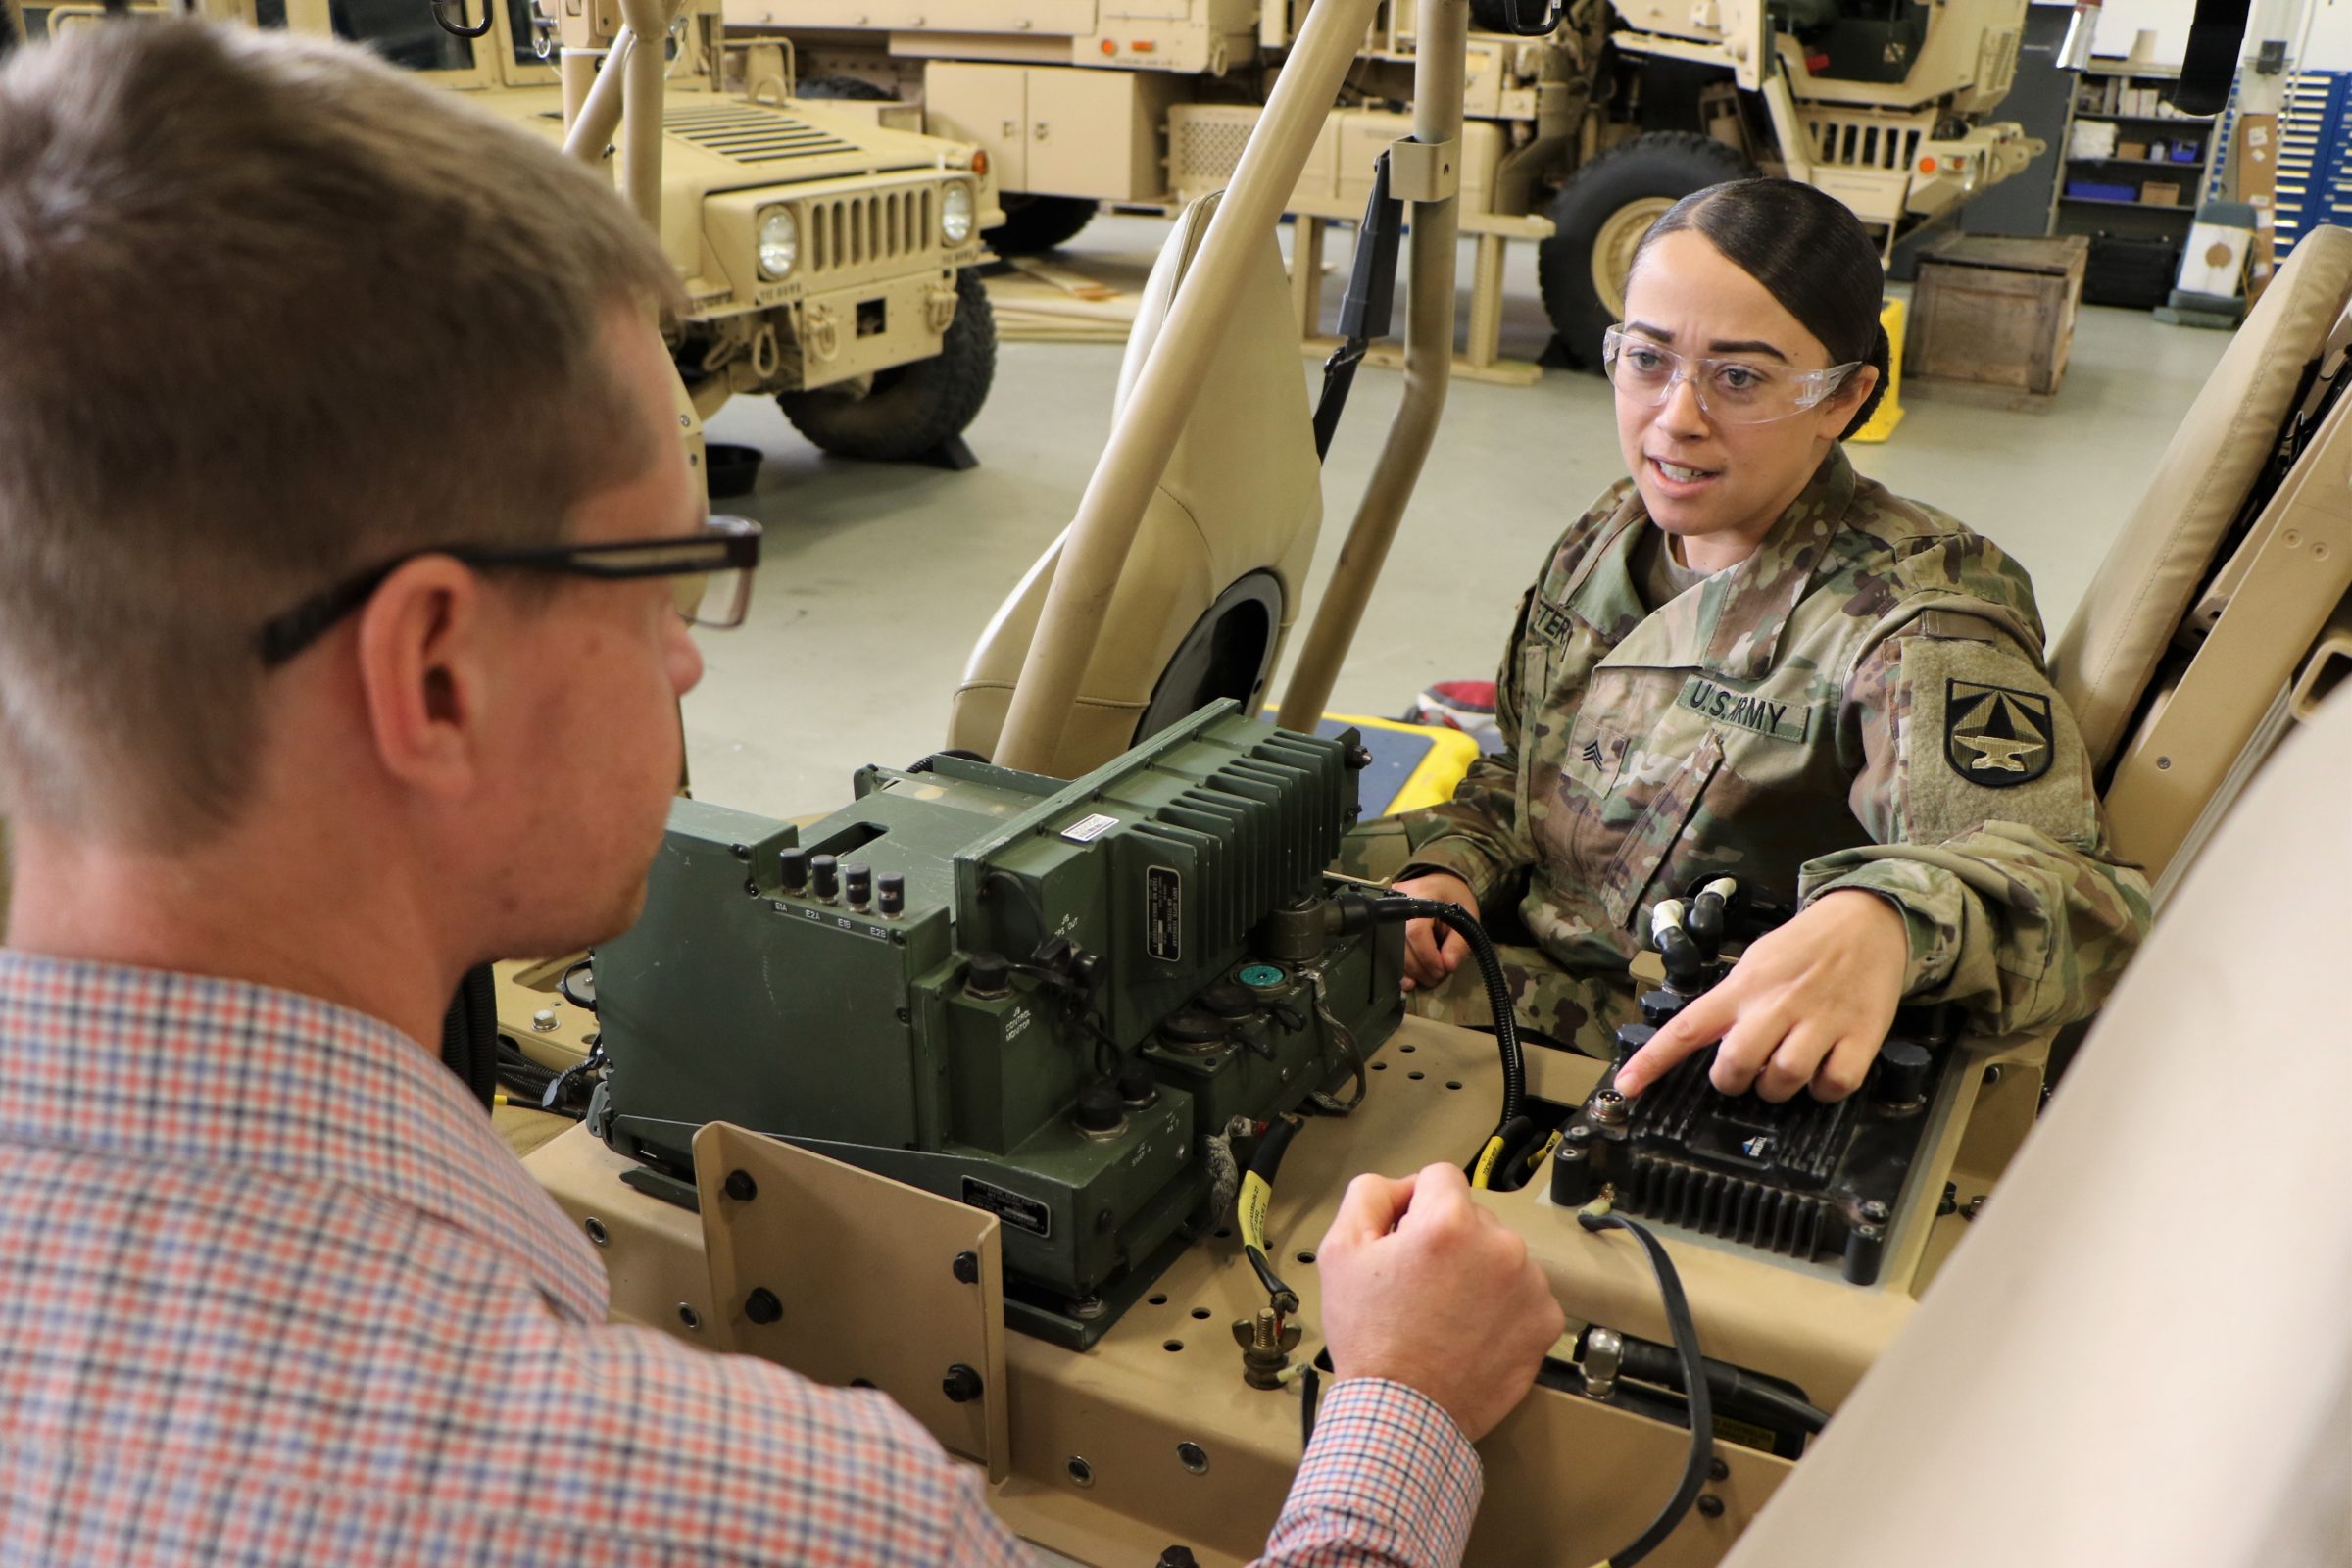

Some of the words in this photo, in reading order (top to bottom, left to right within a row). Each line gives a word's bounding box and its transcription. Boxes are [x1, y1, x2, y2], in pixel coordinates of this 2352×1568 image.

[775, 902, 788, 913] E1A
[805, 909, 821, 921] E2A
[838, 918, 852, 929] E1B
[870, 926, 887, 938] E2B
[1005, 1009, 1031, 1032] CONTROL
[1005, 1018, 1030, 1041] MONITOR
